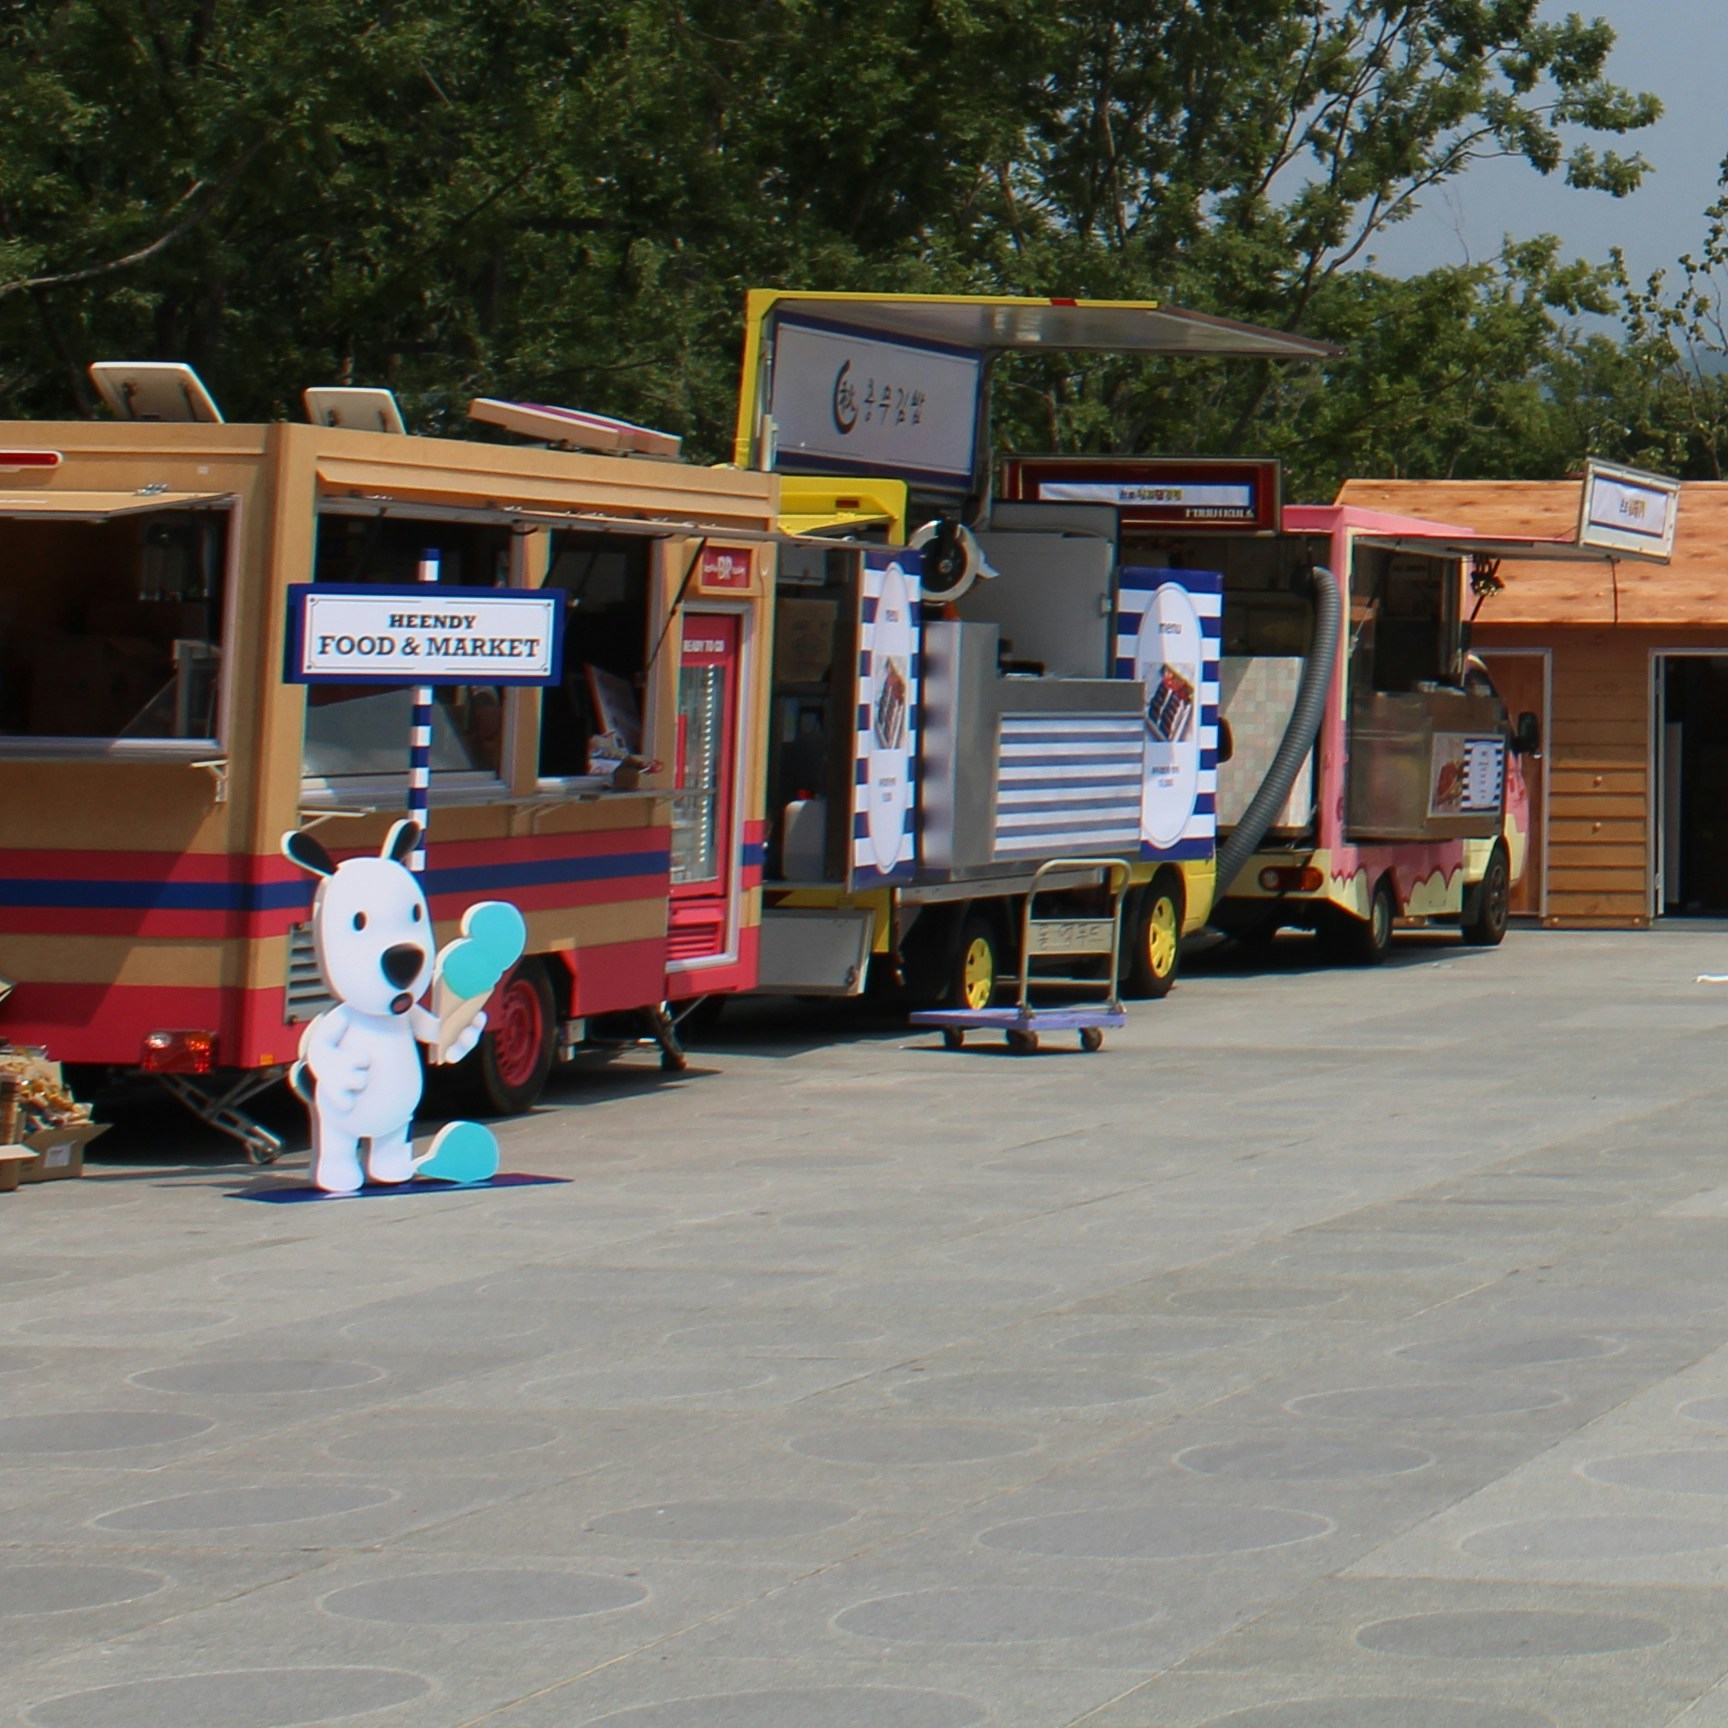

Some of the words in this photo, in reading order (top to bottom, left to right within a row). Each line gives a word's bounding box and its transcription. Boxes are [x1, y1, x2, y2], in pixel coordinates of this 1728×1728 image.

[388, 613, 477, 630] HEENDY
[1158, 622, 1183, 635] menu
[318, 635, 396, 656] FOOD
[401, 637, 421, 656] &
[425, 636, 541, 658] MARKET
[683, 639, 704, 652] READY
